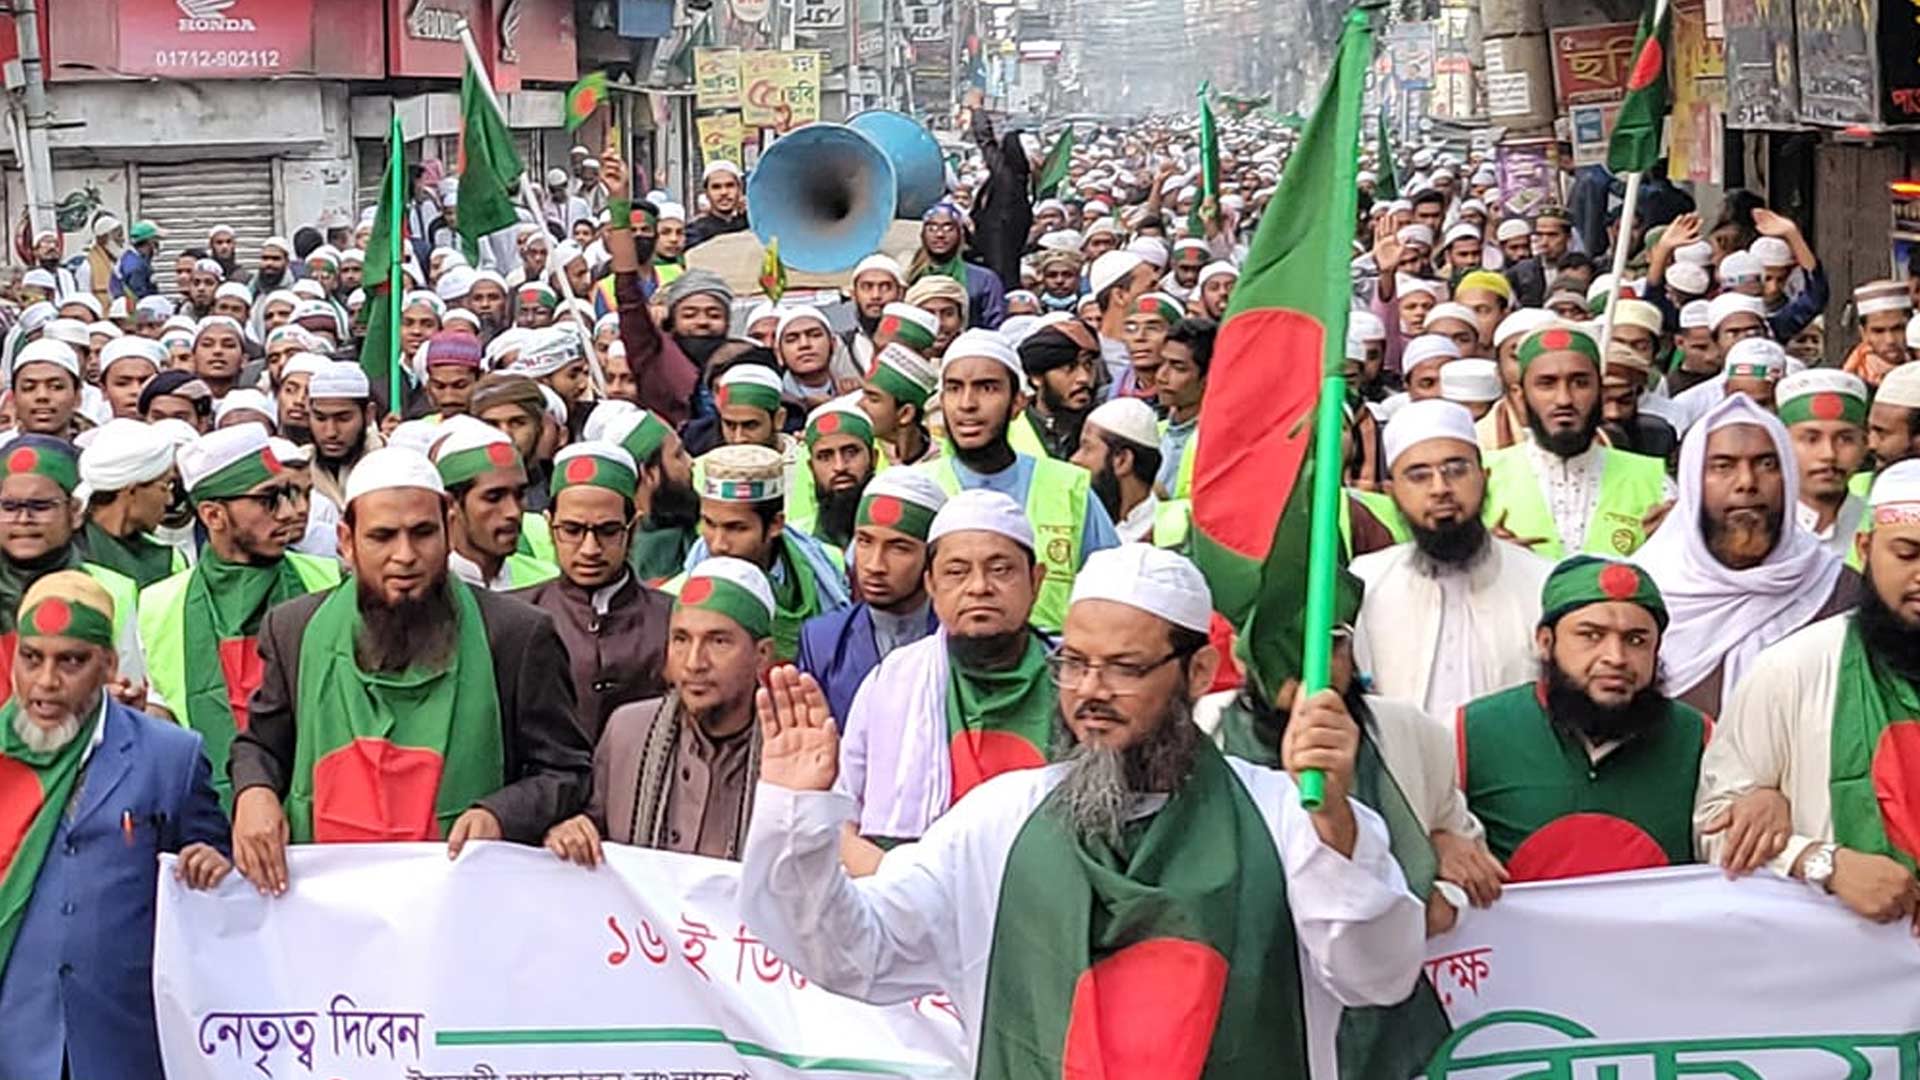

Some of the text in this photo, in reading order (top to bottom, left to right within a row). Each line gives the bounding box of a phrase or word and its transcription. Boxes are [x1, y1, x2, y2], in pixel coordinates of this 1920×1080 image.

[178, 18, 256, 31] HONDA
[156, 50, 280, 67] 01712-902112
[199, 994, 425, 1078] নেতৃত্ব দিবেন
